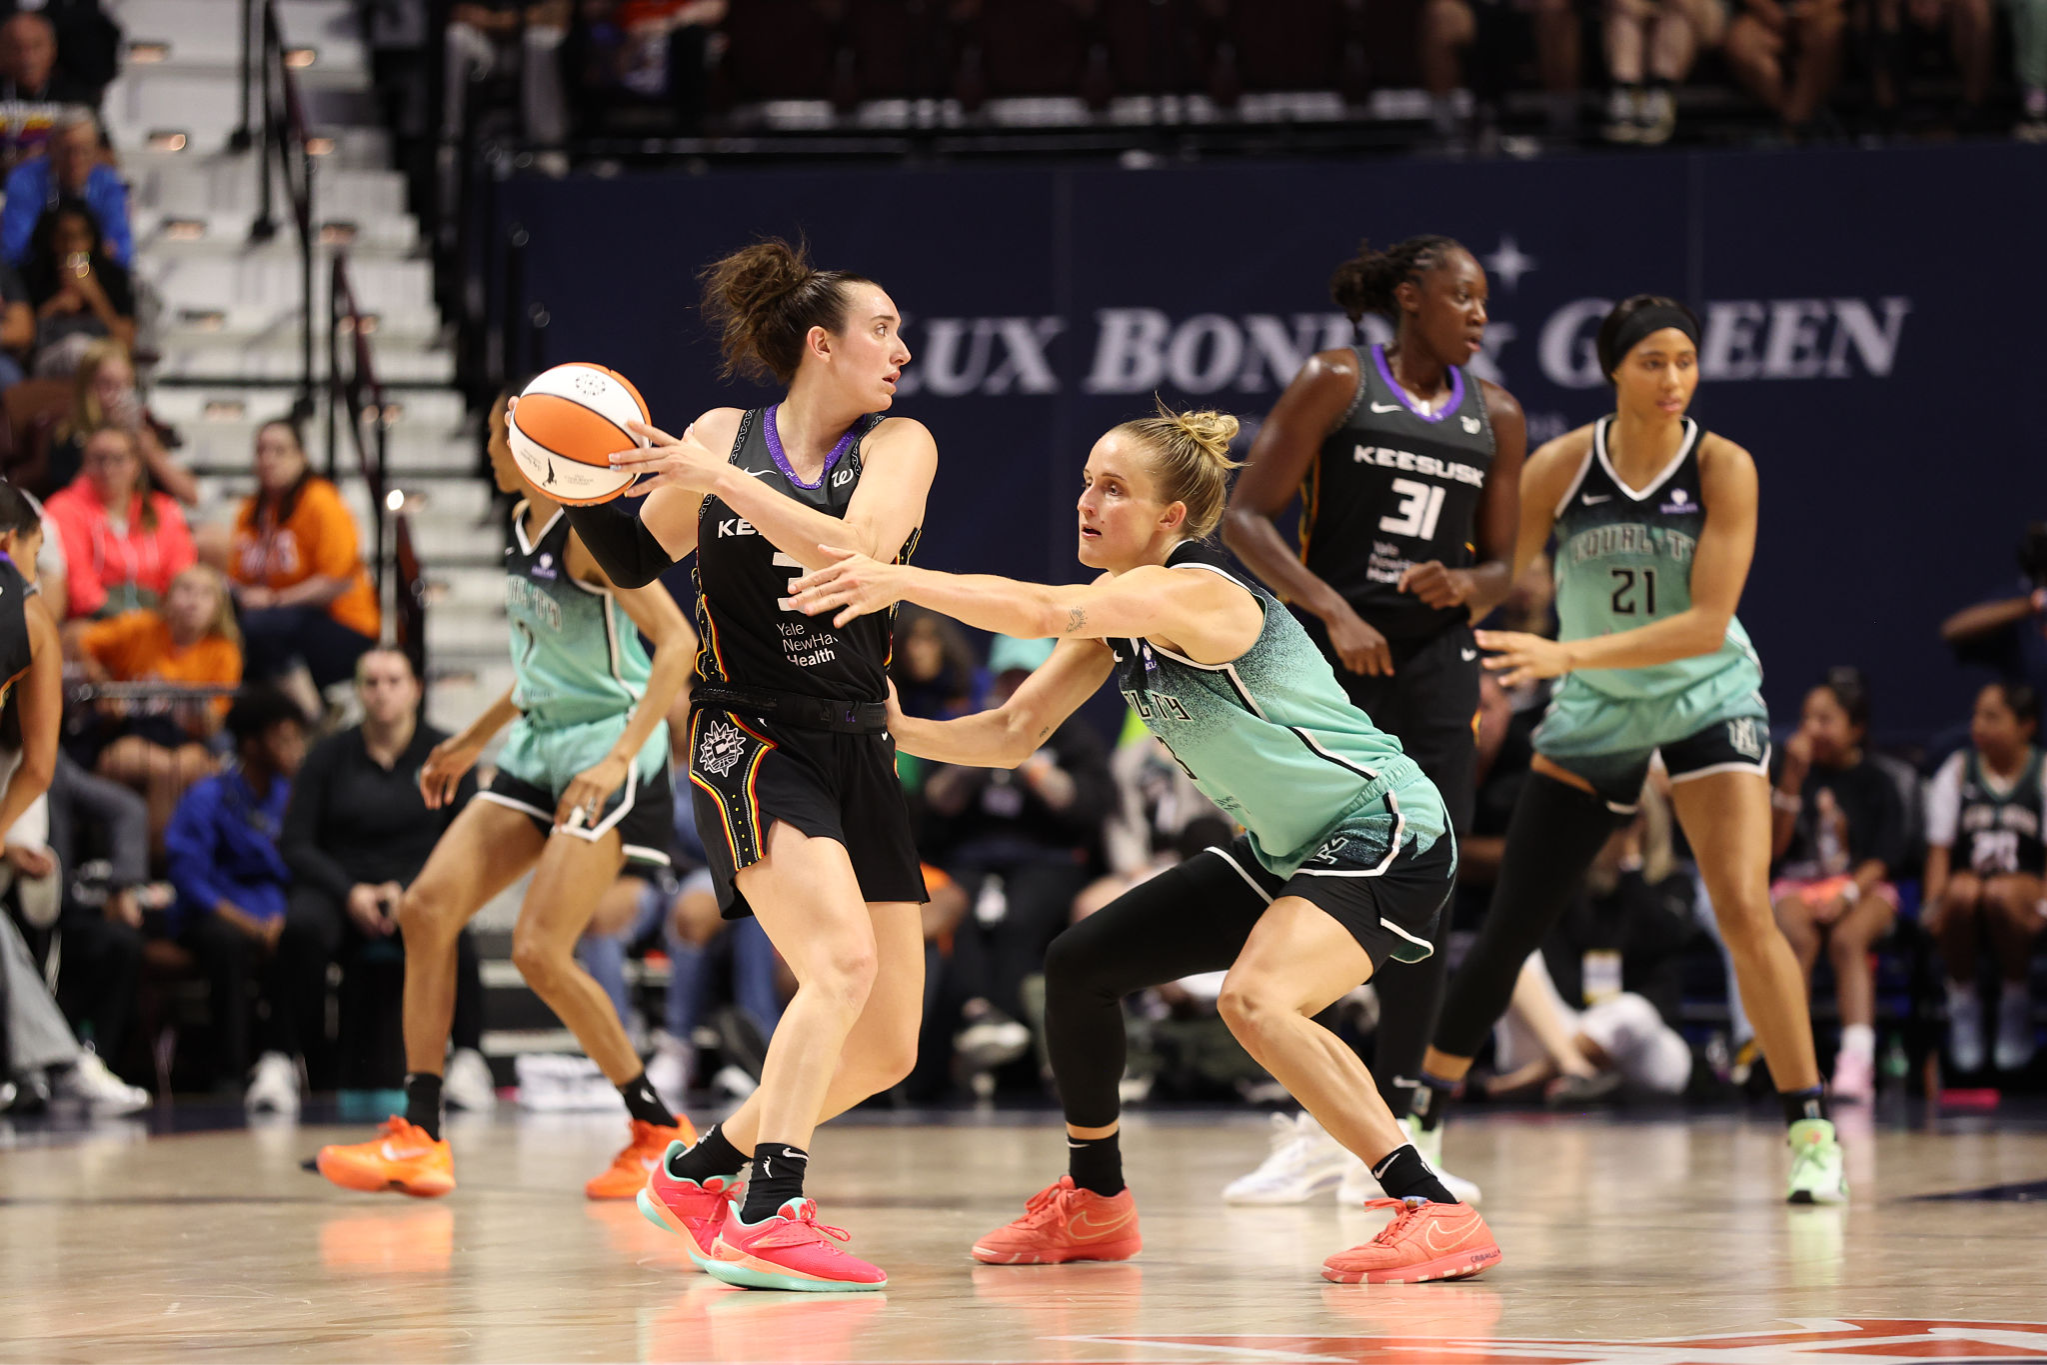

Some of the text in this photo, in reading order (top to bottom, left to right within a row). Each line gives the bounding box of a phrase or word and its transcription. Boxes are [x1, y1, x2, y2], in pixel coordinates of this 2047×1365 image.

[1538, 298, 1910, 389] GEEN
[1354, 445, 1485, 488] KEESUSK
[1379, 478, 1446, 541] 31
[1610, 568, 1657, 616] 21
[776, 622, 805, 637] Yale
